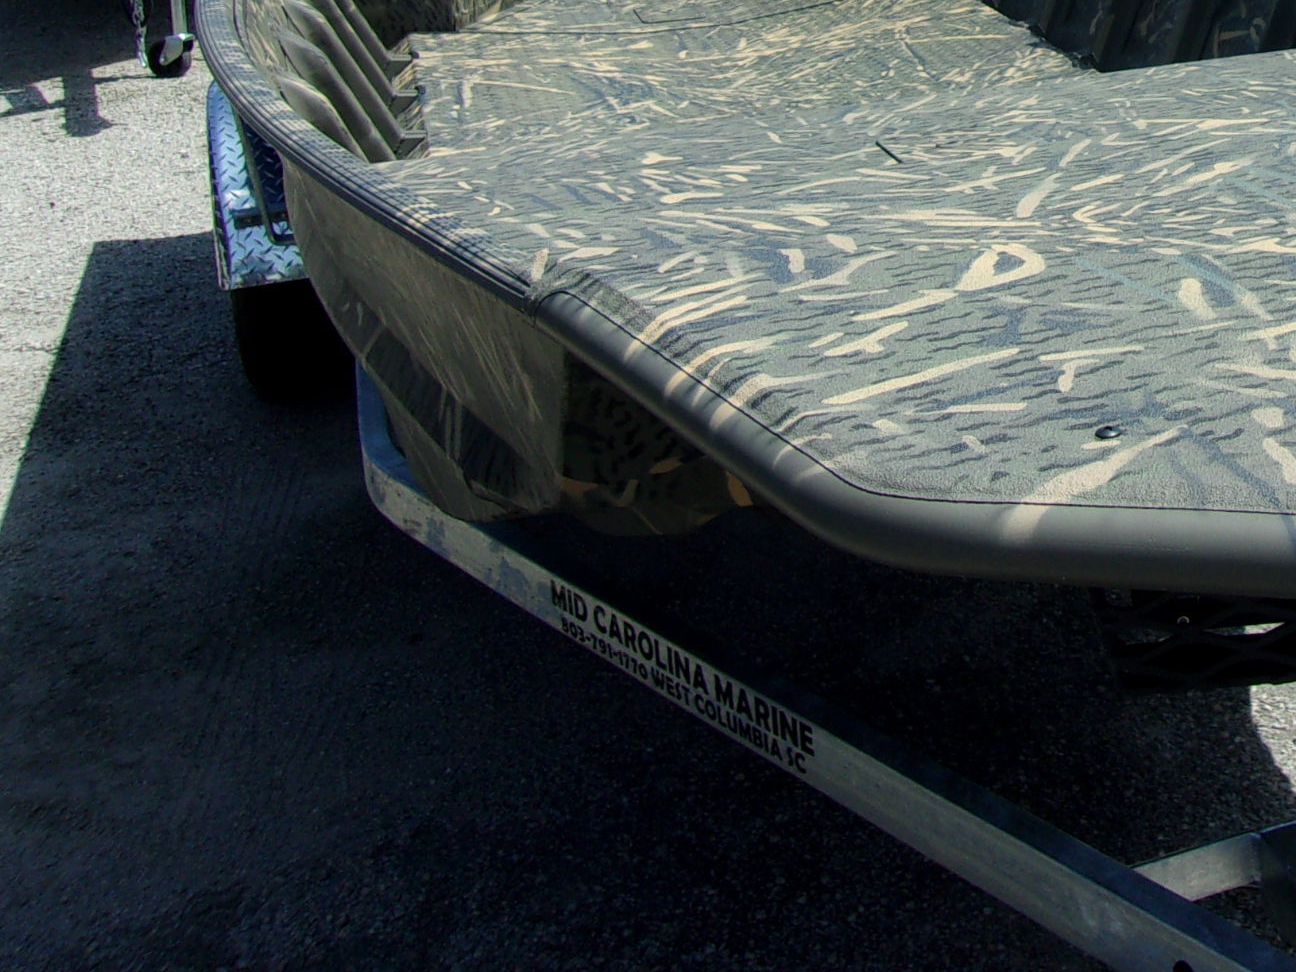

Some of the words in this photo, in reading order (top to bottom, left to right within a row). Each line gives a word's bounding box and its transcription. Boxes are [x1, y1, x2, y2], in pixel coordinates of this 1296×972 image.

[550, 579, 588, 622] MID
[593, 605, 709, 696] CAROLINA
[714, 674, 815, 757] MARINE
[650, 668, 691, 707] WEST
[694, 695, 783, 761] COLUMBIA
[786, 747, 806, 775] SC
